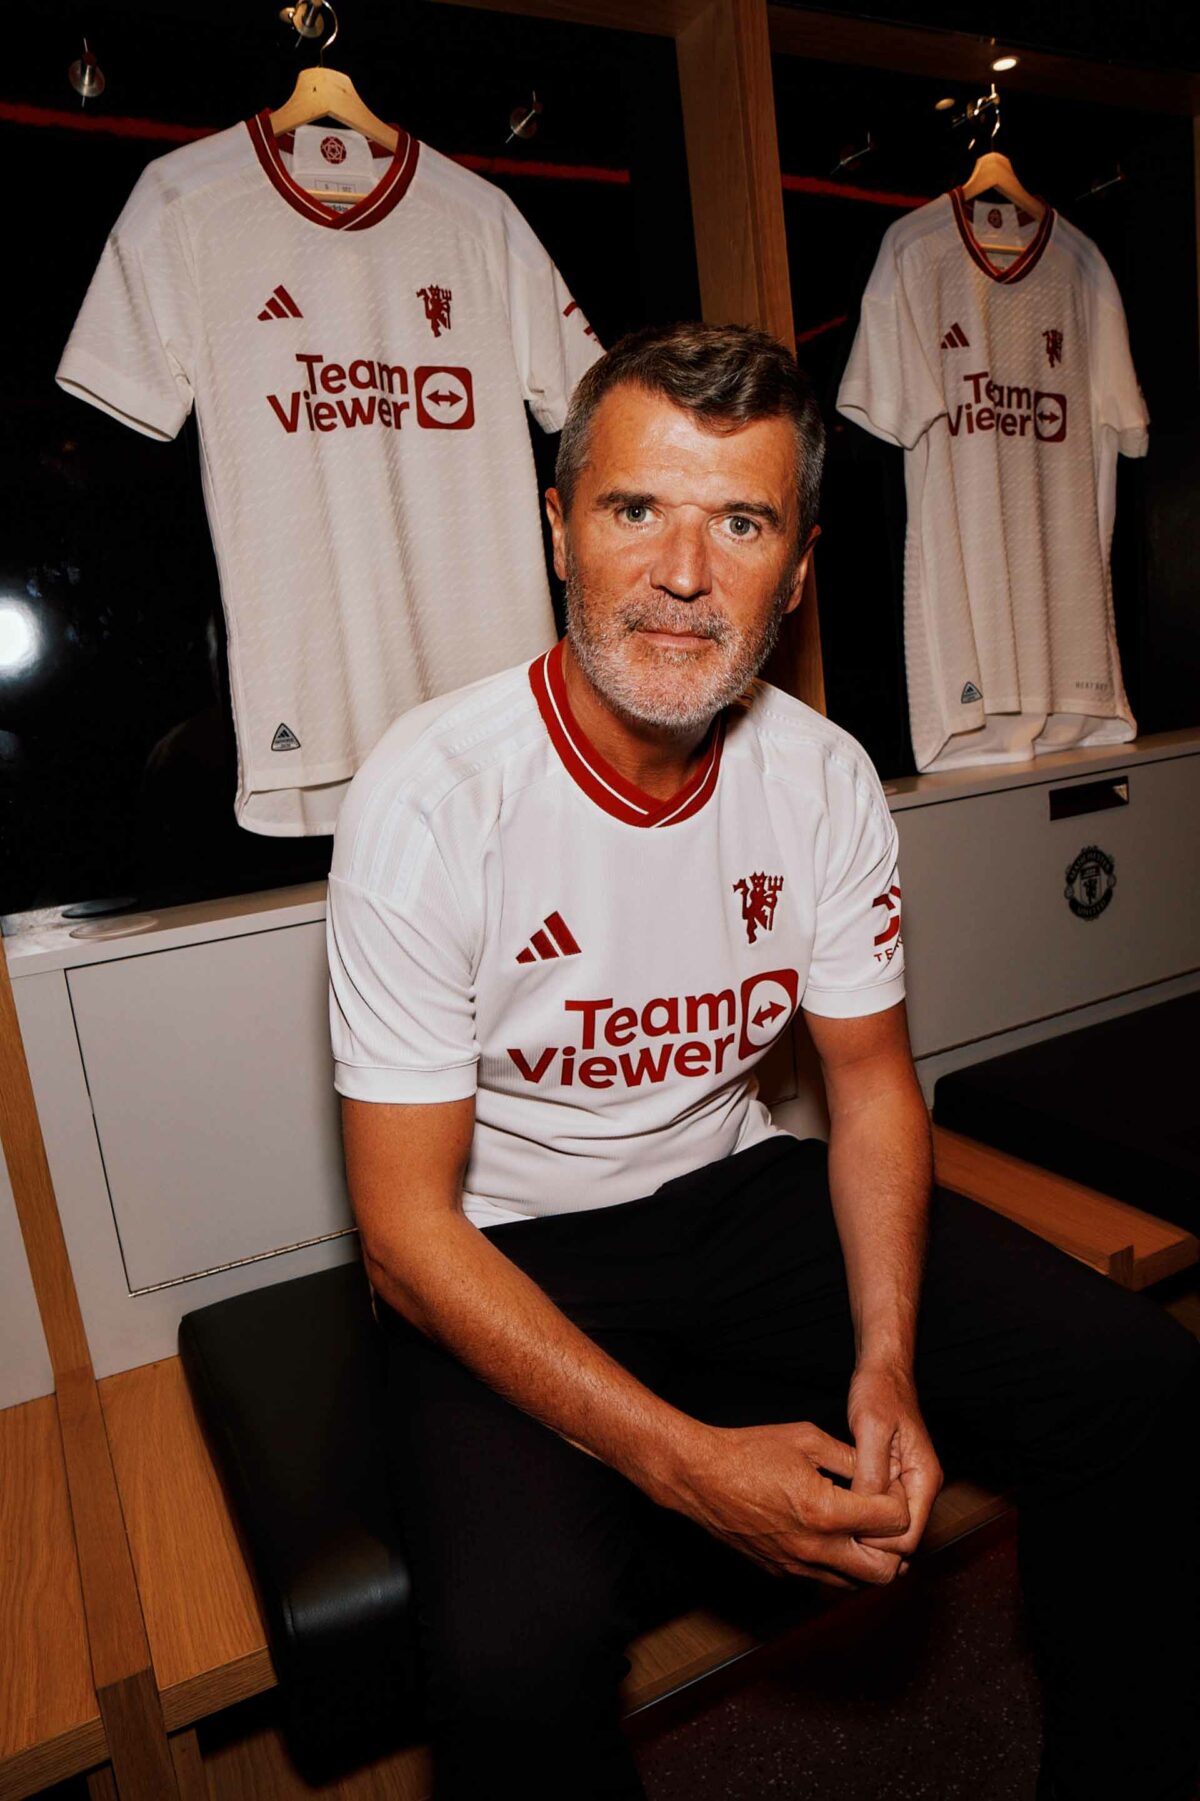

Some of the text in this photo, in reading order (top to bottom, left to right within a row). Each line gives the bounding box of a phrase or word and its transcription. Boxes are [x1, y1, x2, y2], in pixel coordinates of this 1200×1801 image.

[295, 353, 409, 395] Team
[266, 390, 410, 433] Viewer
[564, 989, 736, 1050] Team
[506, 1033, 734, 1089] Viewer
